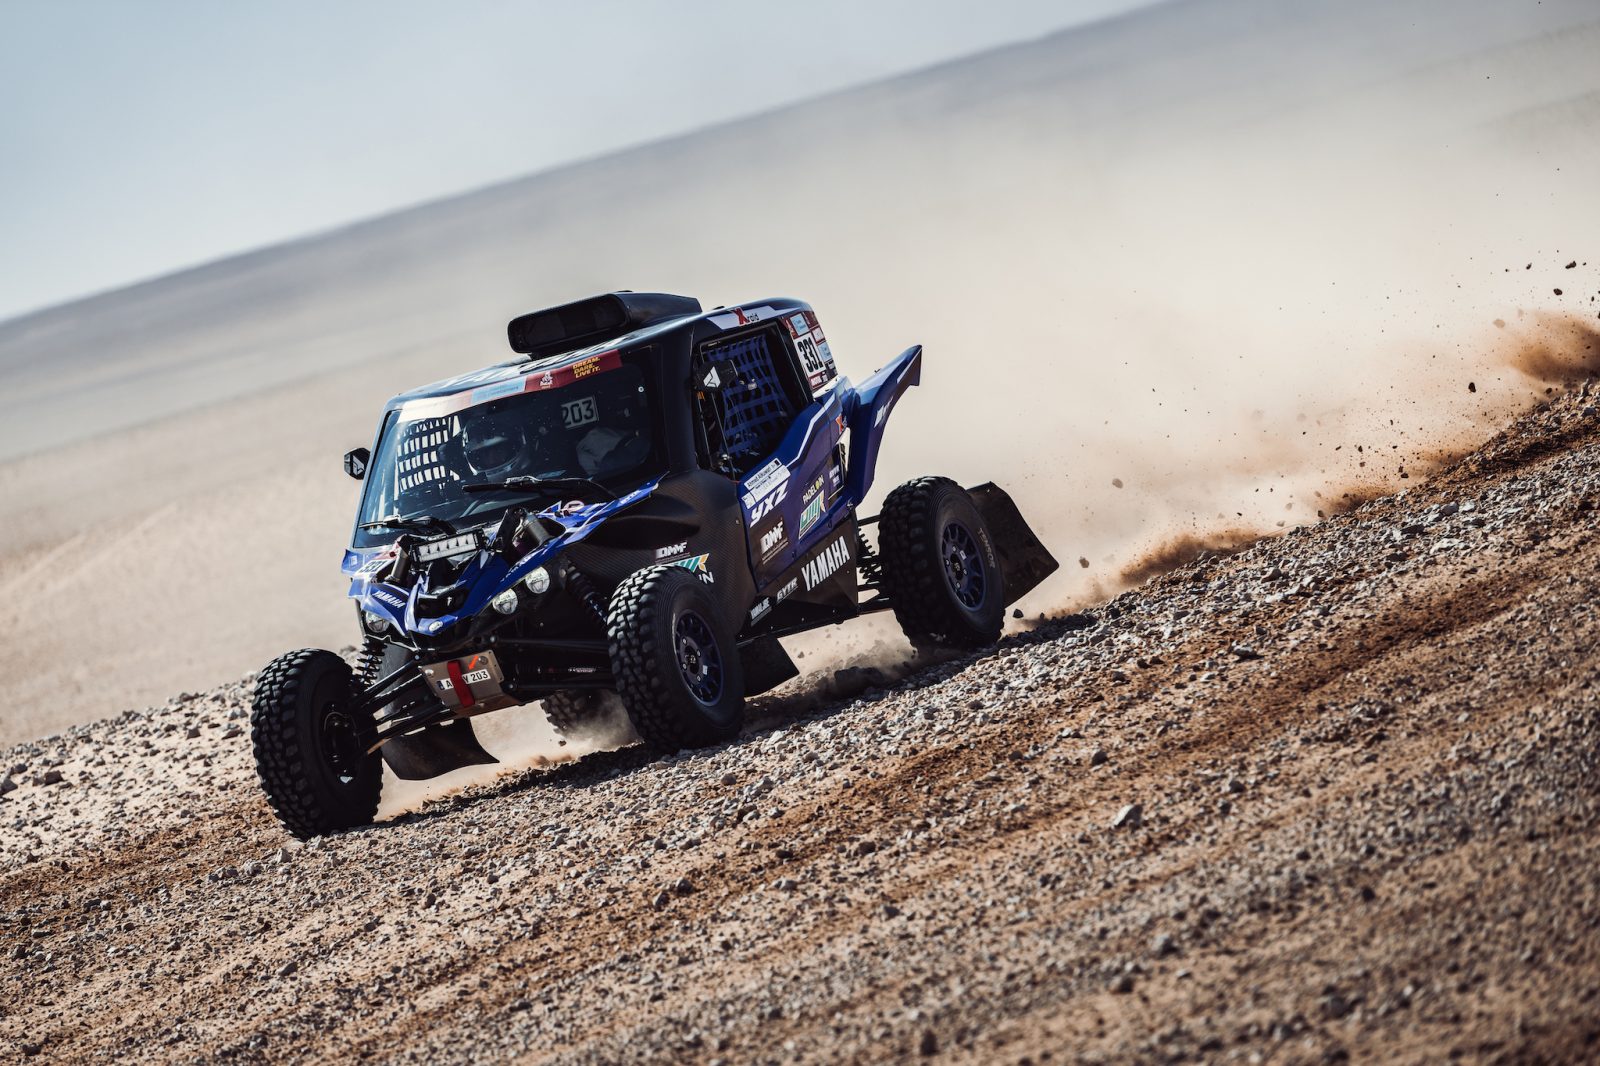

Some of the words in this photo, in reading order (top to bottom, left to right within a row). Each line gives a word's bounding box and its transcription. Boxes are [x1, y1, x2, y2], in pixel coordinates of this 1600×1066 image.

[573, 357, 600, 369] DREAM.
[797, 337, 823, 372] 331
[574, 364, 595, 374] DARE.
[575, 369, 591, 378] LIVE
[562, 399, 594, 425] 203
[750, 480, 789, 527] YXZ
[978, 528, 996, 568] TENSOR
[801, 536, 850, 592] YAMAHA
[372, 590, 407, 609] YAMAHA
[777, 577, 798, 601] GYTR
[445, 680, 453, 688] A
[471, 671, 489, 682] 203
